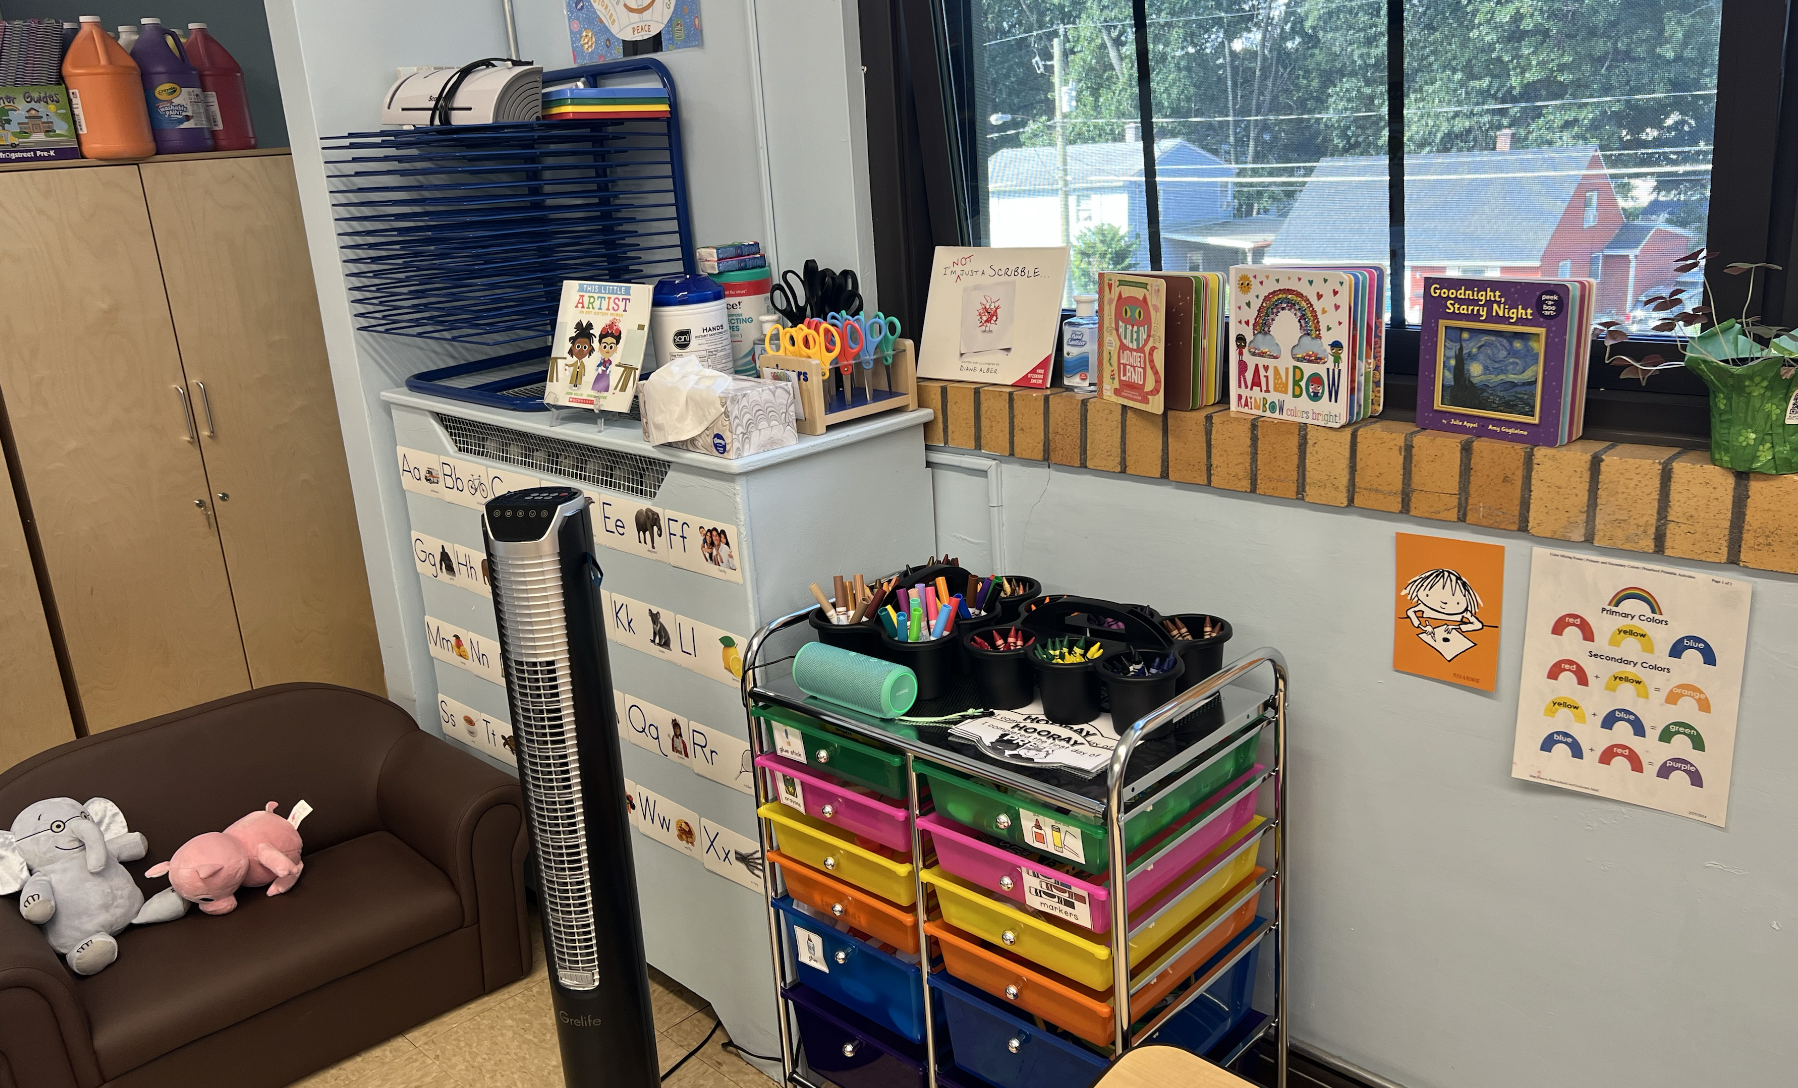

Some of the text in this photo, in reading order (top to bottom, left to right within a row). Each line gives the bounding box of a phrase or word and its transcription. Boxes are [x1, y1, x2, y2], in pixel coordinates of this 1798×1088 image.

[632, 24, 652, 35] PEACE
[23, 90, 61, 105] Guides
[36, 149, 56, 157] Pre-K
[952, 254, 974, 268] NOT
[959, 269, 979, 277] JUST
[583, 284, 626, 295] THIS LITTLE
[1430, 284, 1506, 305] Goodnight,
[574, 294, 631, 313] ARTIST
[1445, 300, 1534, 322] Starry Night
[702, 324, 724, 334] HANDS
[1119, 349, 1145, 368] WONDER
[959, 364, 998, 375] DIANE ALBER
[1120, 364, 1144, 385] LAND
[1286, 406, 1310, 419] colors
[1311, 408, 1341, 425] bright!
[1450, 418, 1462, 426] Julie
[1463, 420, 1478, 429] Appel
[1487, 424, 1500, 433] Amy
[401, 453, 422, 482] Aa
[441, 461, 465, 492] Bb
[602, 501, 626, 536] Ee
[667, 517, 691, 553] Ff
[414, 537, 438, 578] Gg
[455, 549, 478, 582] Hh
[613, 600, 636, 635] Kk
[1565, 617, 1581, 625] red
[1601, 607, 1669, 626] Primary Colors
[426, 621, 454, 654] Mm
[678, 622, 697, 658] Ll
[1617, 627, 1647, 639] yellow
[469, 637, 490, 669] Nn
[1683, 638, 1705, 649] blue
[1561, 662, 1577, 671] red
[1587, 650, 1671, 674] Secondary Colors
[1613, 674, 1643, 686] yellow
[1672, 686, 1706, 700] orange
[440, 700, 456, 727] Ss
[1551, 700, 1580, 711] yellow
[1615, 710, 1636, 721] blue
[482, 718, 497, 747] Tt
[628, 704, 668, 758] Qq
[1010, 723, 1085, 747] HOORAY
[1553, 733, 1573, 743] blue
[1669, 724, 1697, 736] green
[692, 728, 719, 766] Rr
[779, 746, 790, 754] glue
[987, 724, 1031, 740] completed
[1031, 736, 1048, 745] the
[1071, 748, 1087, 757] day
[1613, 747, 1629, 756] red
[1666, 760, 1697, 773] purple
[784, 795, 802, 808] crayons
[638, 791, 671, 833] Ww
[703, 825, 733, 866] Xx
[1040, 900, 1079, 921] markers
[559, 1010, 602, 1027] Grelife
